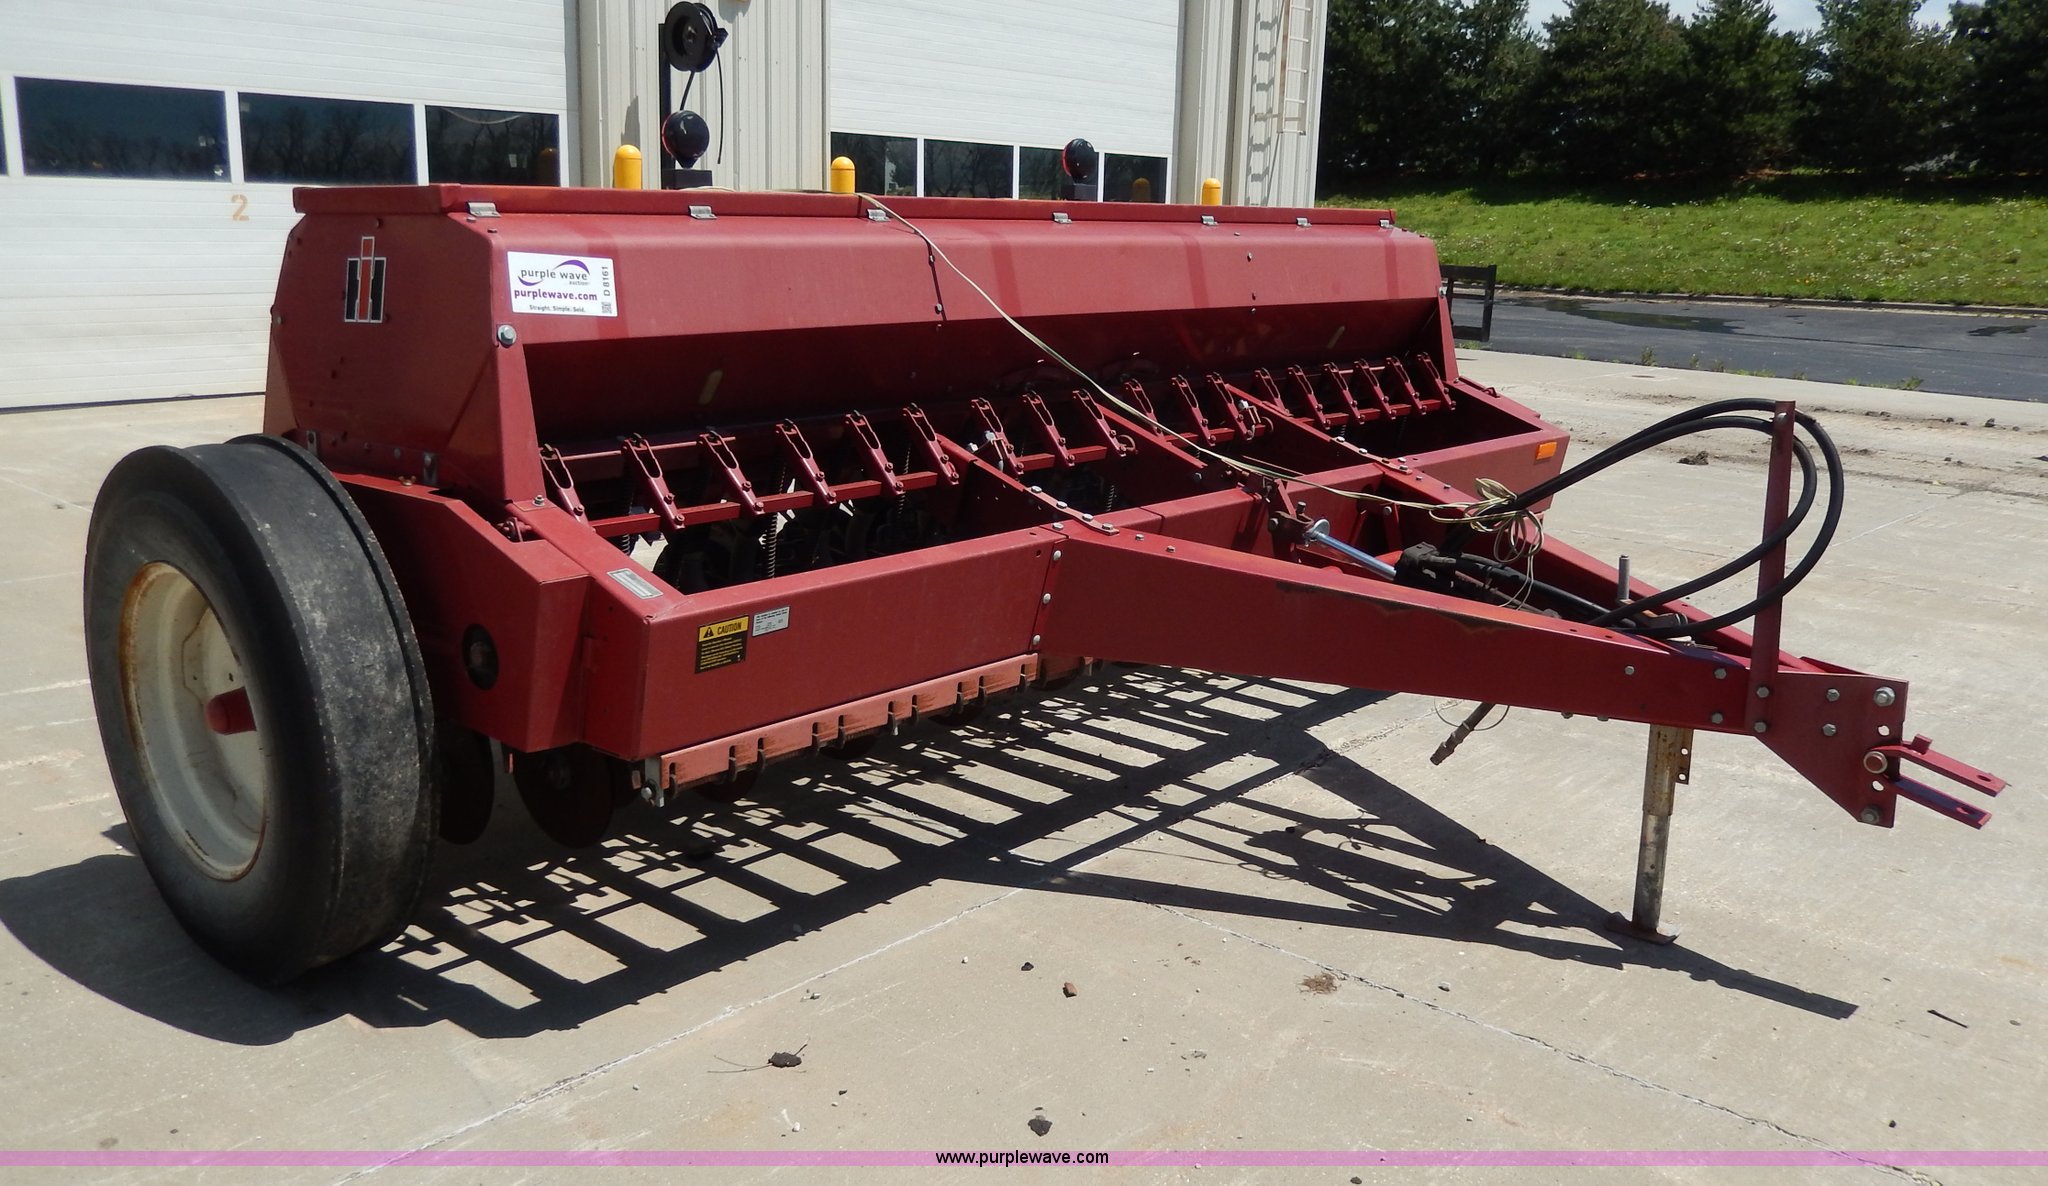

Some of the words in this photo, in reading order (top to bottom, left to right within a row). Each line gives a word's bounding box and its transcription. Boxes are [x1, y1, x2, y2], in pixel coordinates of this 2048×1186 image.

[231, 194, 249, 221] 2
[521, 269, 556, 279] purple
[560, 272, 587, 280] wave
[514, 289, 598, 301] purplewave.com
[717, 621, 742, 635] CAUTION
